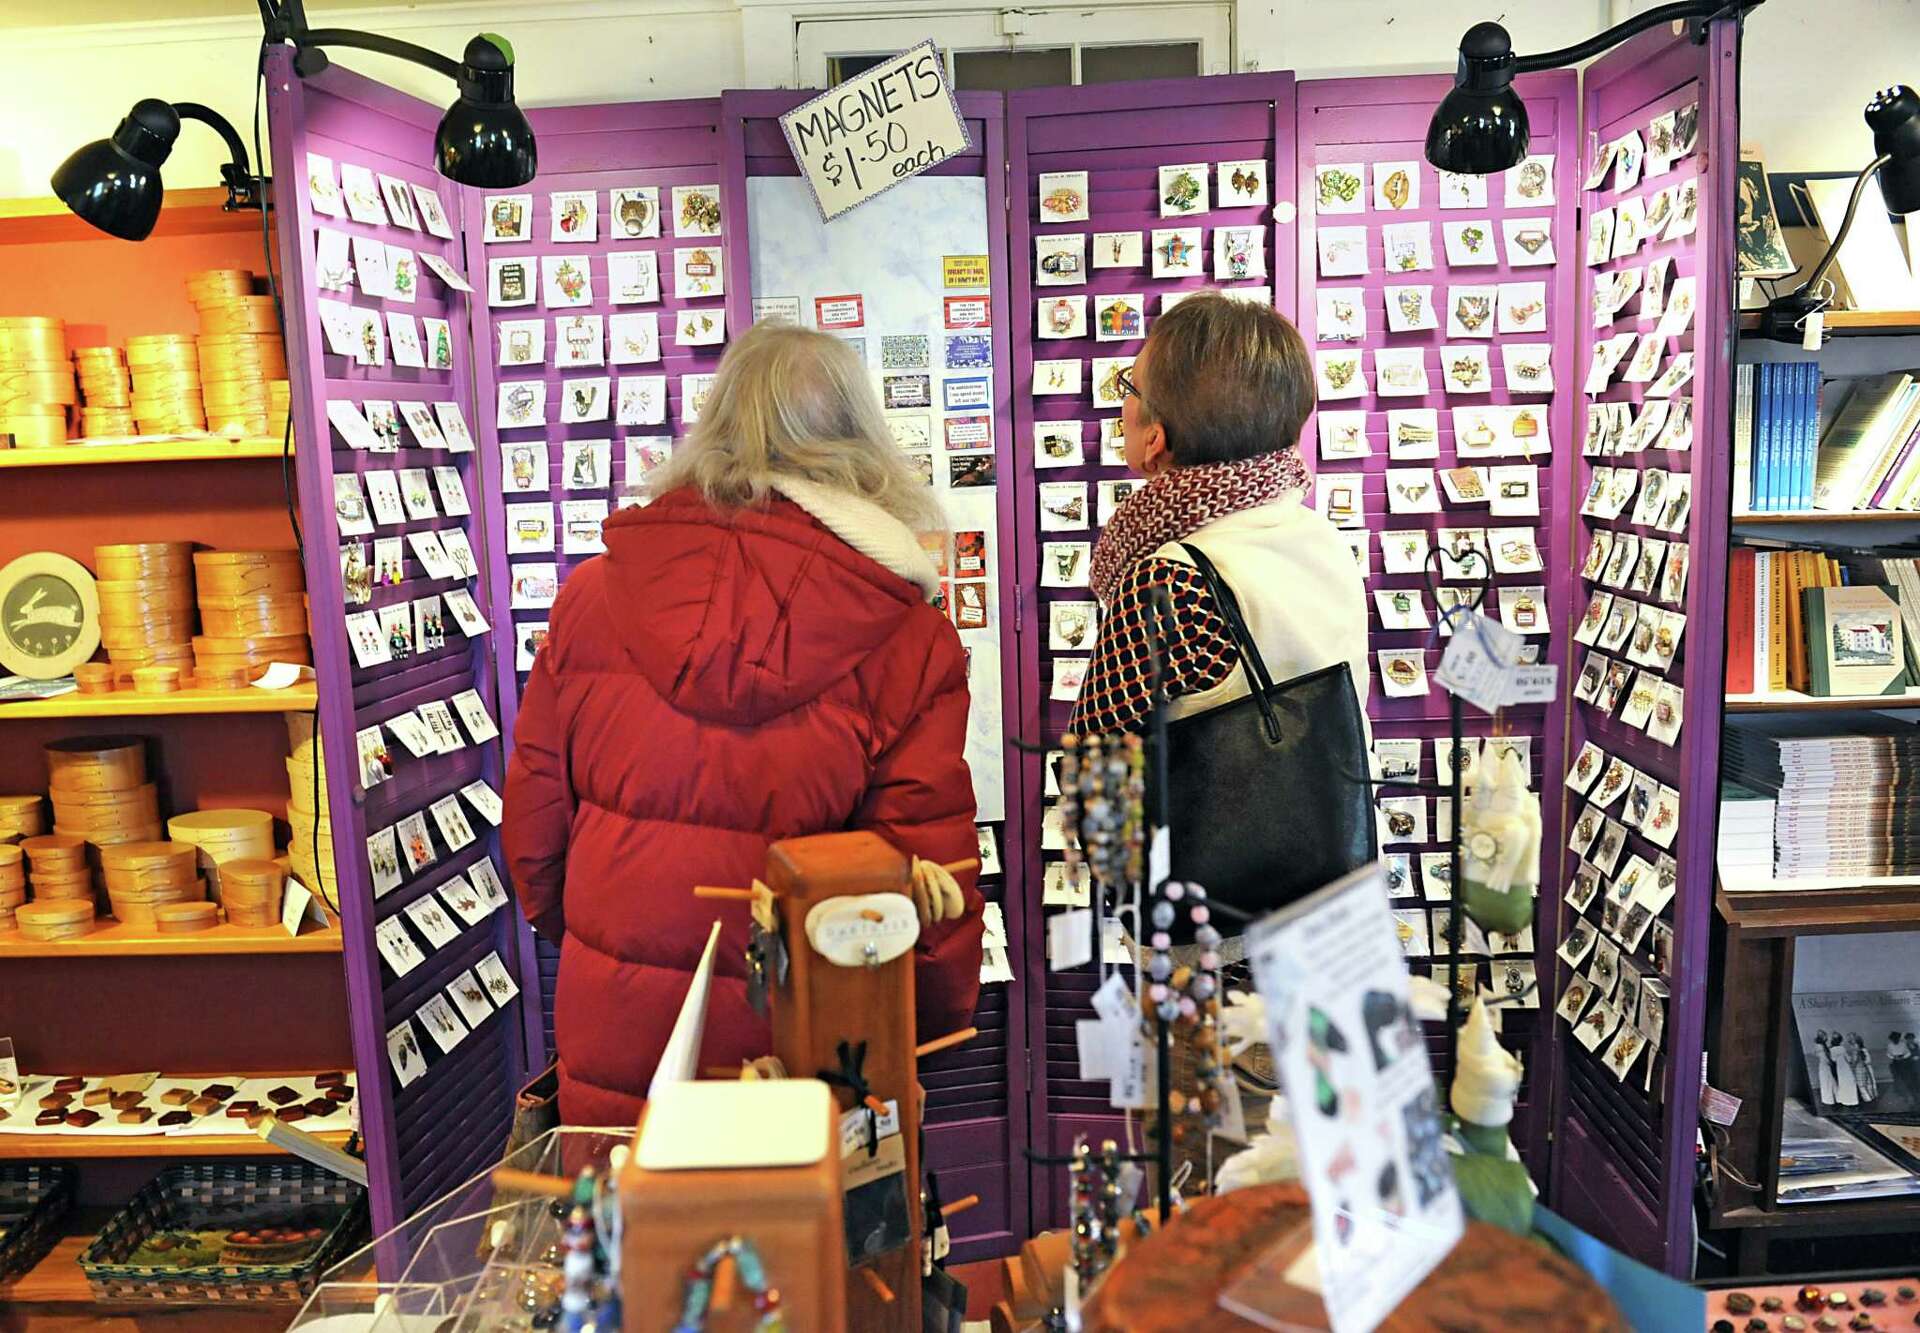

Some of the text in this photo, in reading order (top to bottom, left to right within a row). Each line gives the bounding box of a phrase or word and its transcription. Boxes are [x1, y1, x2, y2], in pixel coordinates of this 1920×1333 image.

[795, 55, 941, 156] MAGNETS
[822, 122, 908, 190] $1.50
[892, 140, 945, 178] each
